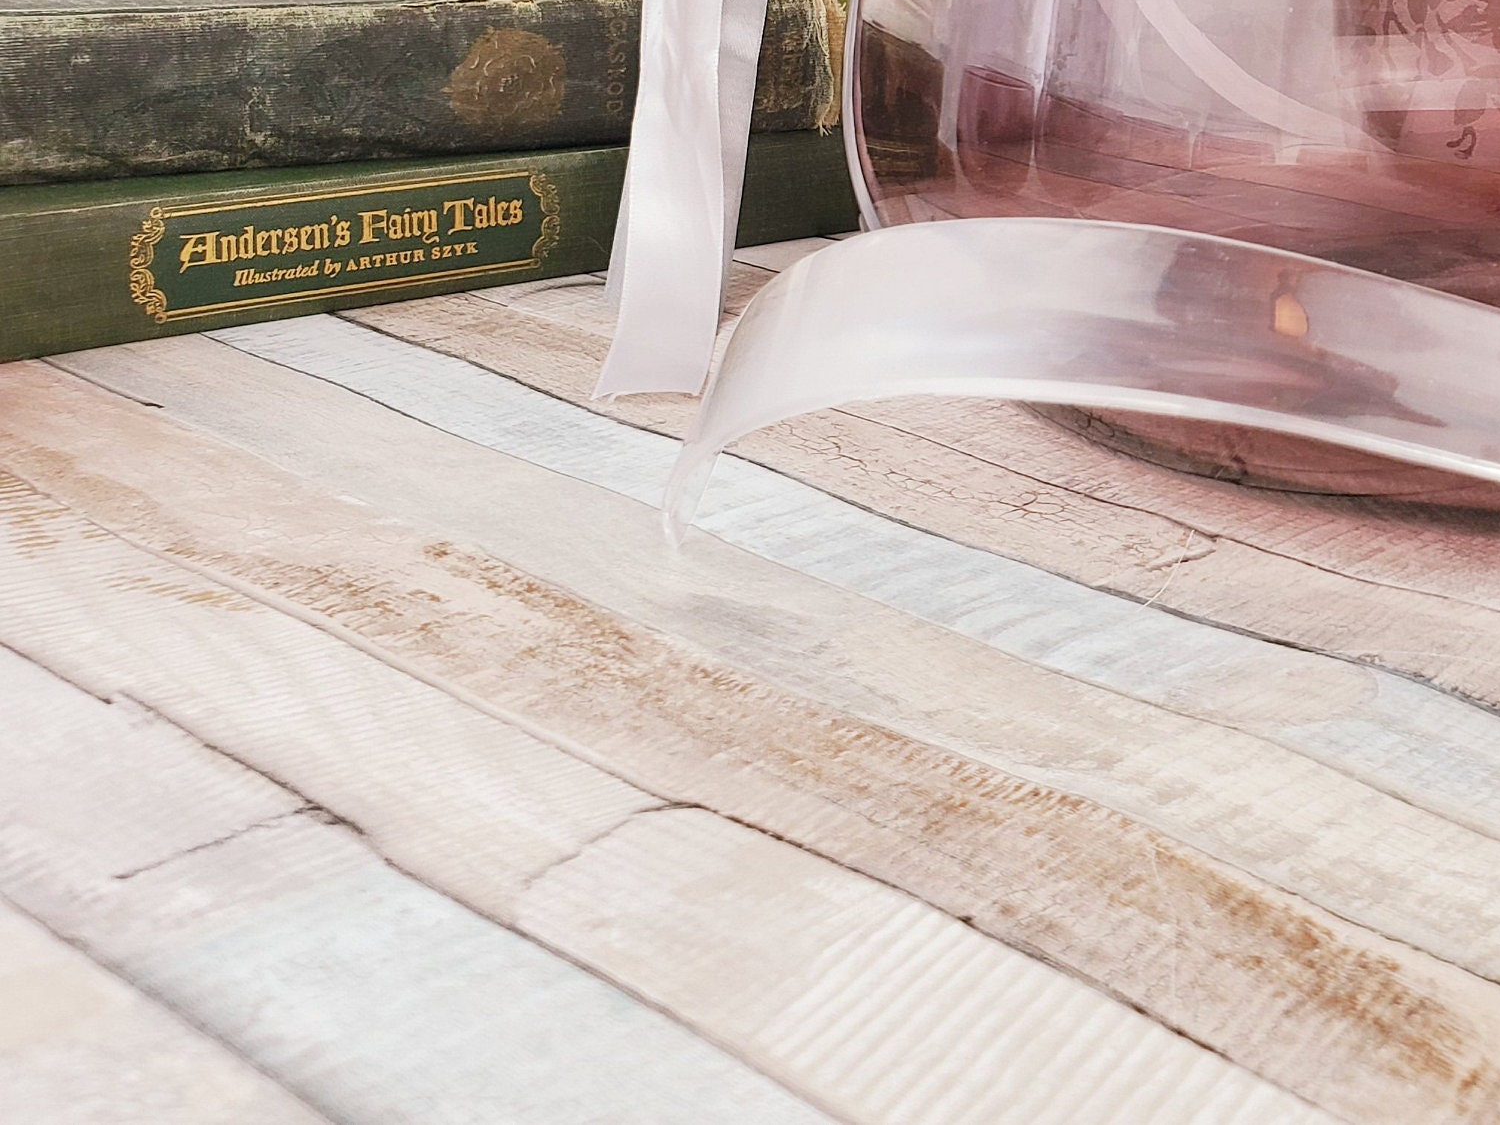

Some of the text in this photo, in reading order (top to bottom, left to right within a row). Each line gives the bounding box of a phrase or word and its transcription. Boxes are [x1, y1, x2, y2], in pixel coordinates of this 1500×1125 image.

[179, 196, 523, 274] Andersen's Fairy Tales
[233, 242, 479, 287] Illustrated by ARTHUR SZYK
